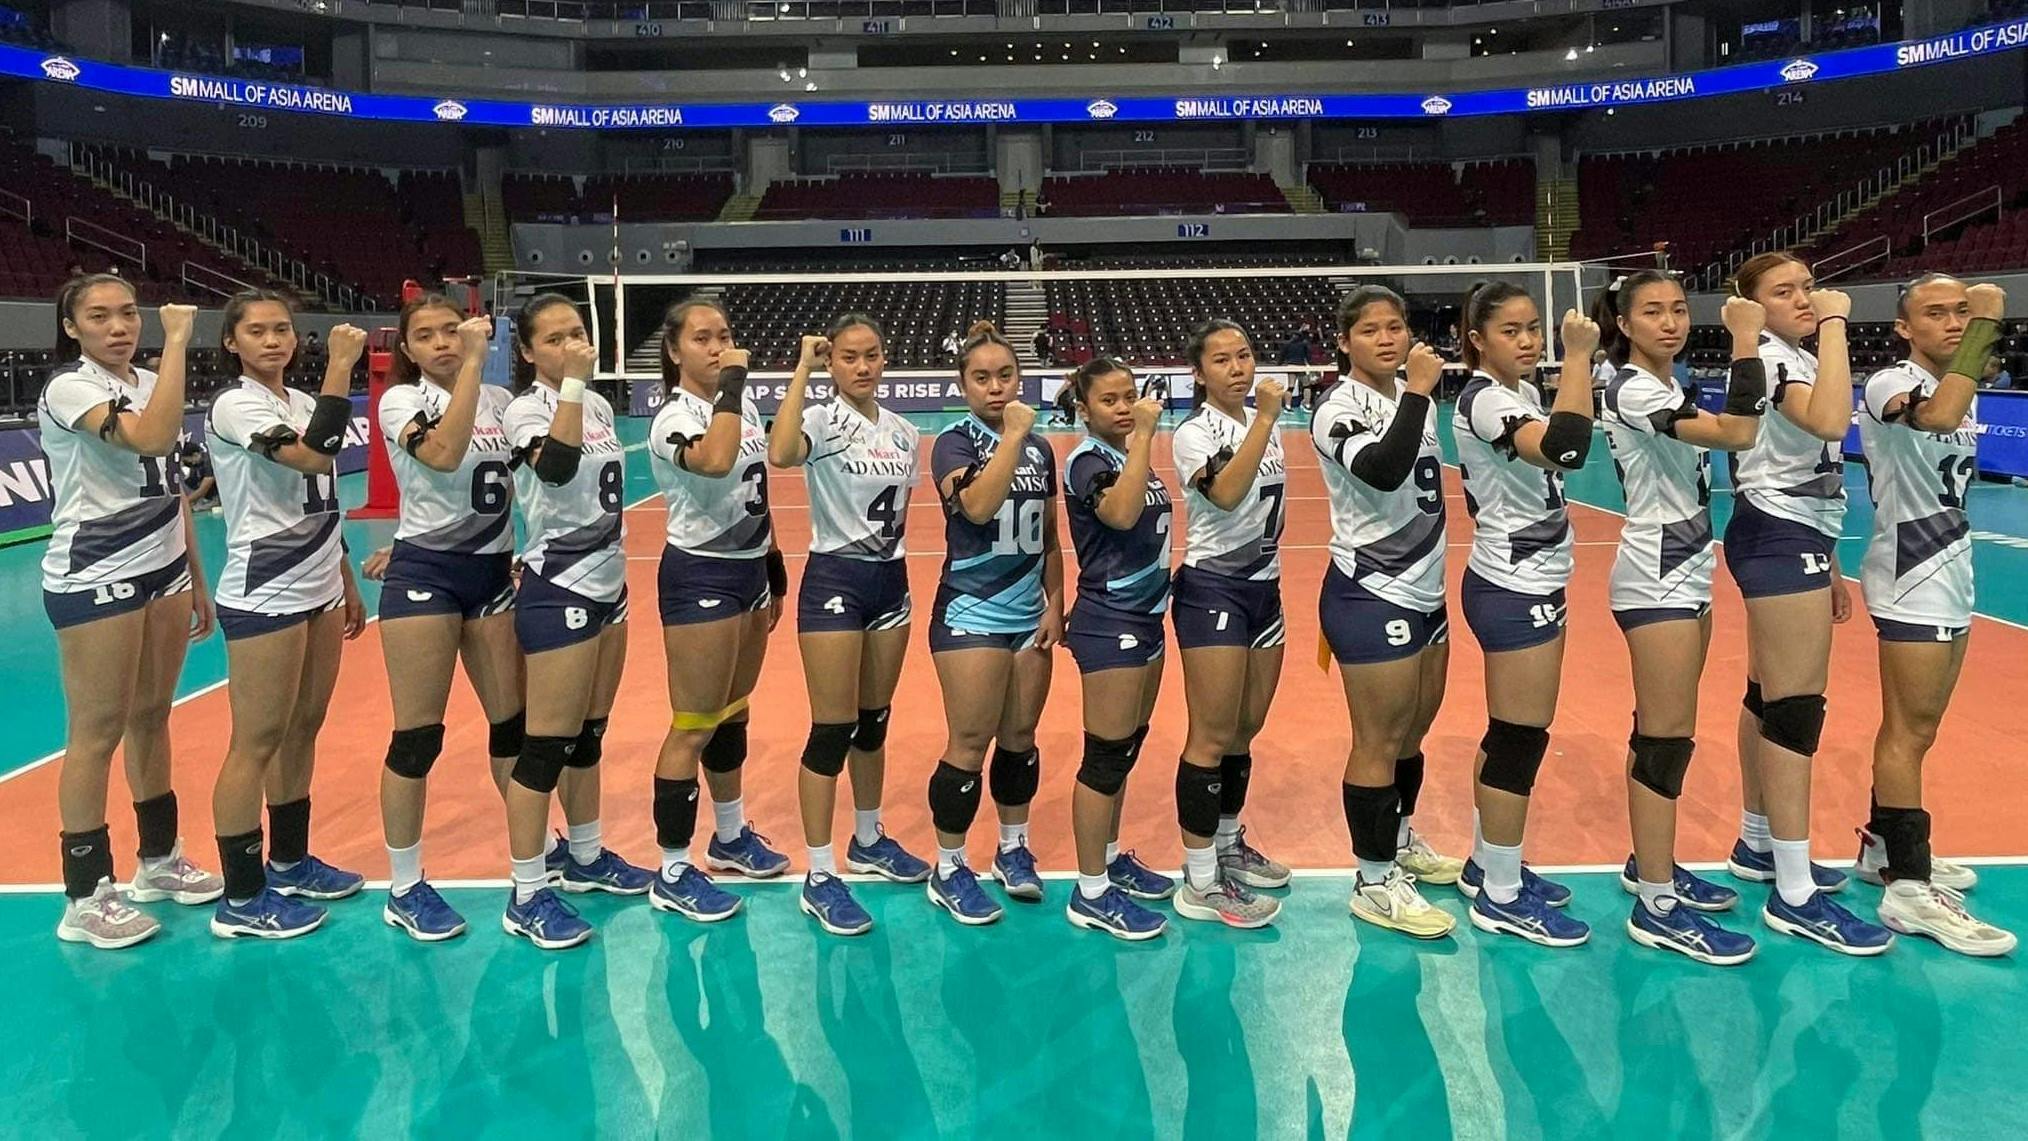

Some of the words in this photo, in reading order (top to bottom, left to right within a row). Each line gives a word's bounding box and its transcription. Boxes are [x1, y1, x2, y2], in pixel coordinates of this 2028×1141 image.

[1150, 17, 1172, 29] 412
[1365, 14, 1388, 25] 413
[638, 25, 660, 36] 410
[1971, 29, 1995, 52] OF
[1591, 84, 1611, 102] OF
[1613, 81, 1645, 100] ASIA
[1646, 77, 1695, 97] ARENA
[1778, 91, 1803, 106] 214
[245, 85, 266, 103] OF
[268, 87, 302, 108] ASIA
[303, 91, 353, 113] ARENA
[1233, 100, 1250, 116] OF
[1251, 99, 1280, 116] ASIA
[1281, 98, 1323, 115] ARENA
[592, 110, 608, 126] OF
[611, 109, 639, 126] ASIA
[640, 108, 683, 125] ARENA
[926, 104, 943, 120] OF
[945, 104, 974, 120] ASIA
[975, 103, 1016, 120] ARENA
[238, 113, 268, 129] 209
[1135, 130, 1155, 142] 212
[1358, 127, 1377, 139] 213
[664, 138, 685, 150] 210
[847, 229, 865, 242] 111
[1184, 224, 1205, 237] 112
[895, 383, 931, 399] RISE
[868, 448, 901, 460] Akari
[841, 460, 913, 479] ADAMSO
[472, 461, 508, 515] 6
[599, 460, 624, 515] 8
[742, 460, 768, 517] 3
[1414, 455, 1443, 516] 9
[867, 484, 901, 539] 4
[1259, 483, 1285, 554] 7
[992, 499, 1045, 556] 10
[823, 595, 846, 615] 4
[564, 606, 589, 631] 8
[1208, 609, 1229, 632] 7
[1385, 619, 1413, 647] 9
